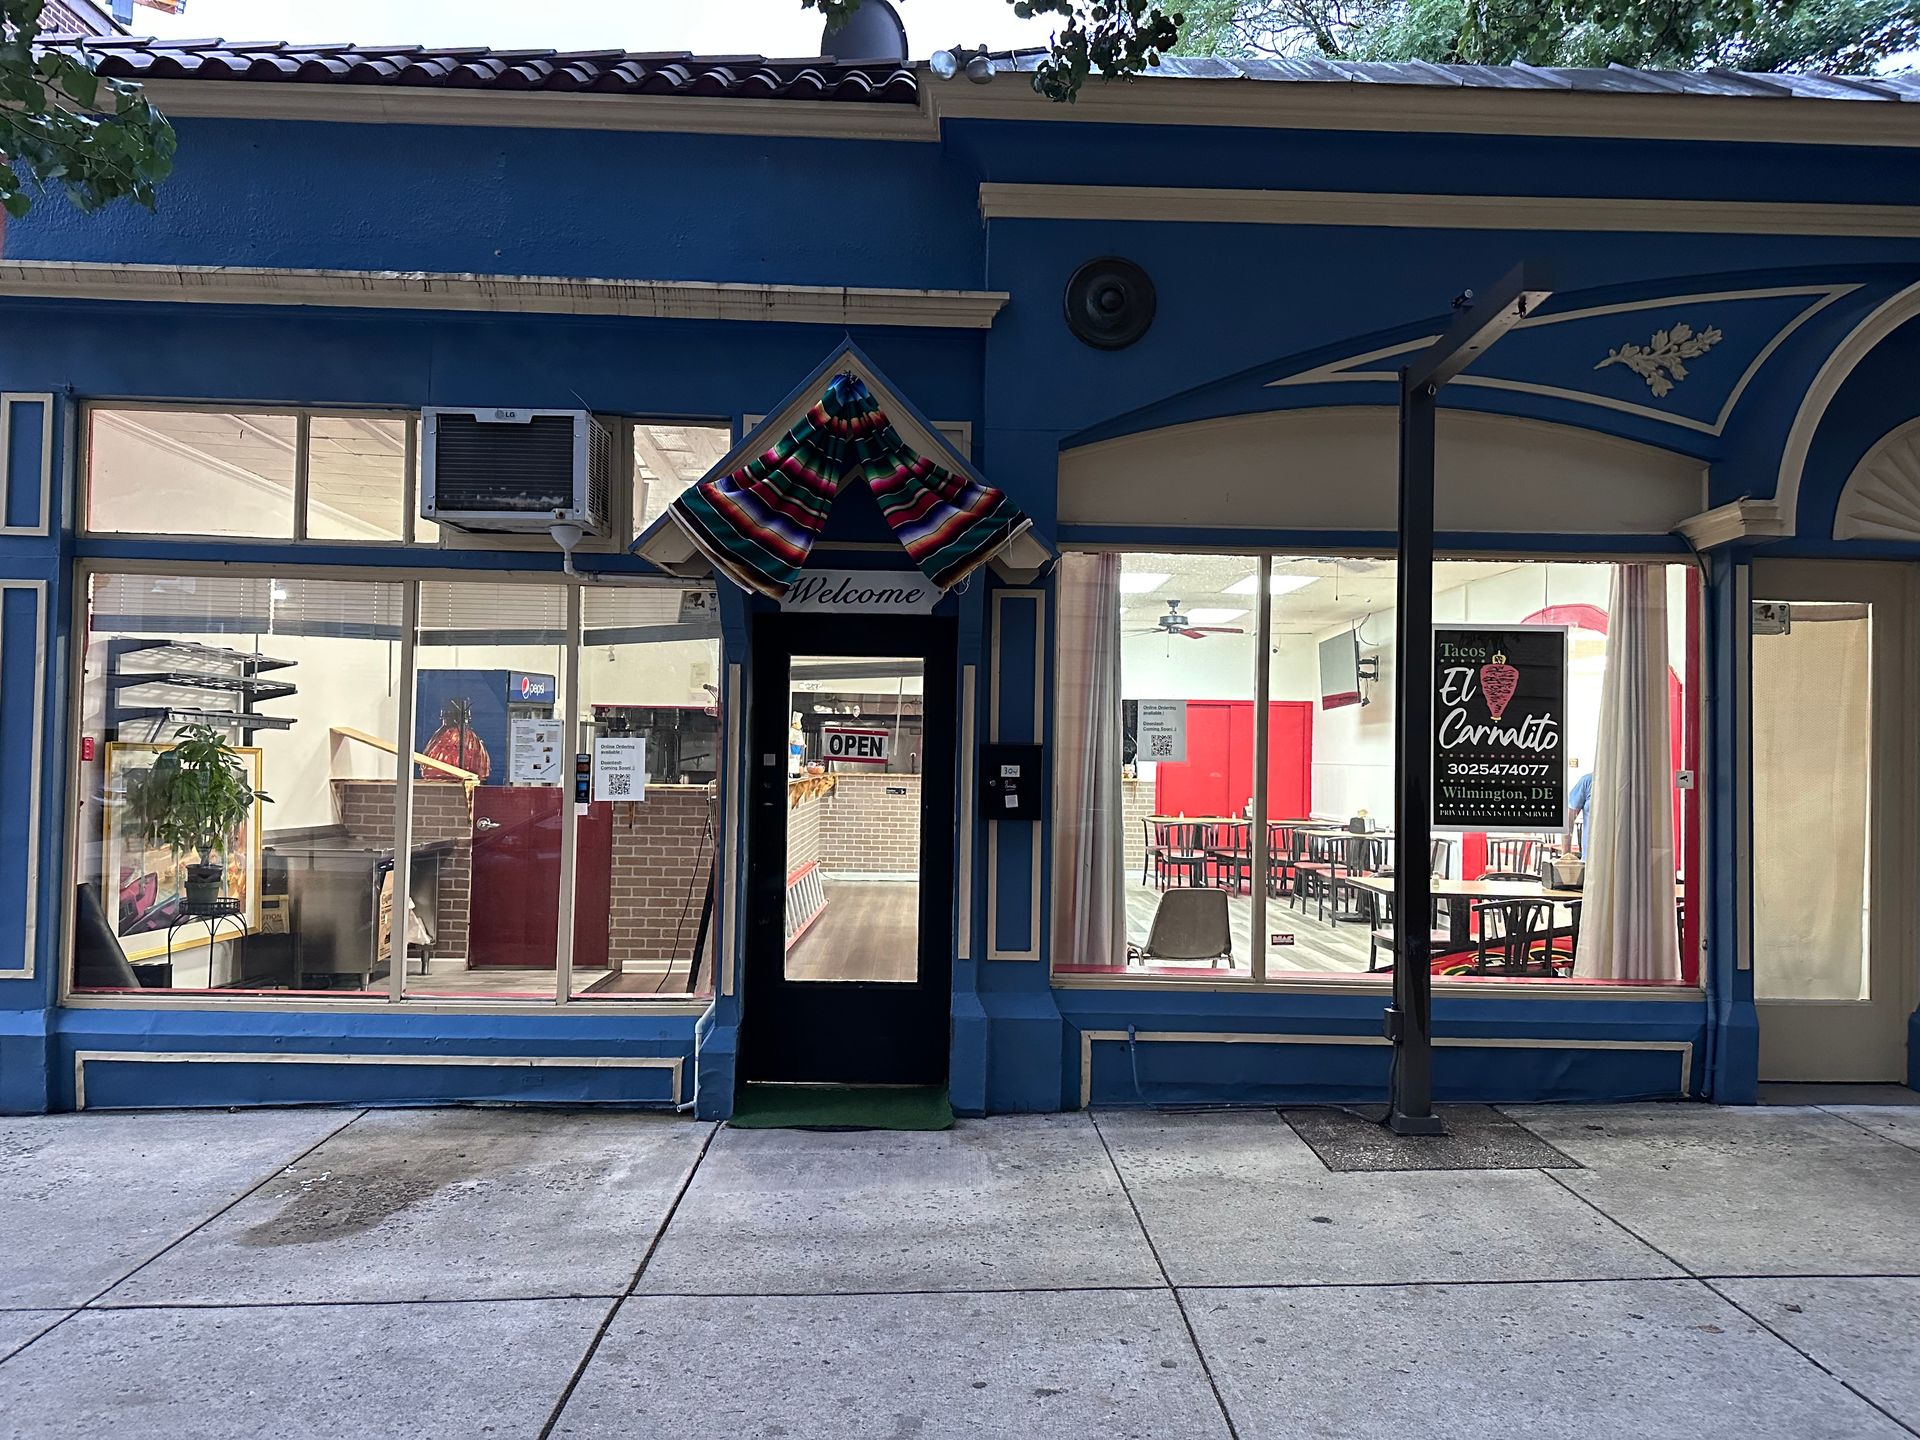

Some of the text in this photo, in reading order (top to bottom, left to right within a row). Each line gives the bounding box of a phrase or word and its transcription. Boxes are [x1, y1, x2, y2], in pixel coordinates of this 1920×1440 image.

[788, 576, 926, 604] Welcome
[1440, 643, 1486, 657] Tacos
[529, 683, 545, 696] pepsi
[1439, 666, 1477, 706] El
[1439, 707, 1559, 752] Carnalito
[829, 734, 883, 757] OPEN
[1447, 764, 1549, 776] 3025474077
[1443, 786, 1553, 802] Wilmington, DE
